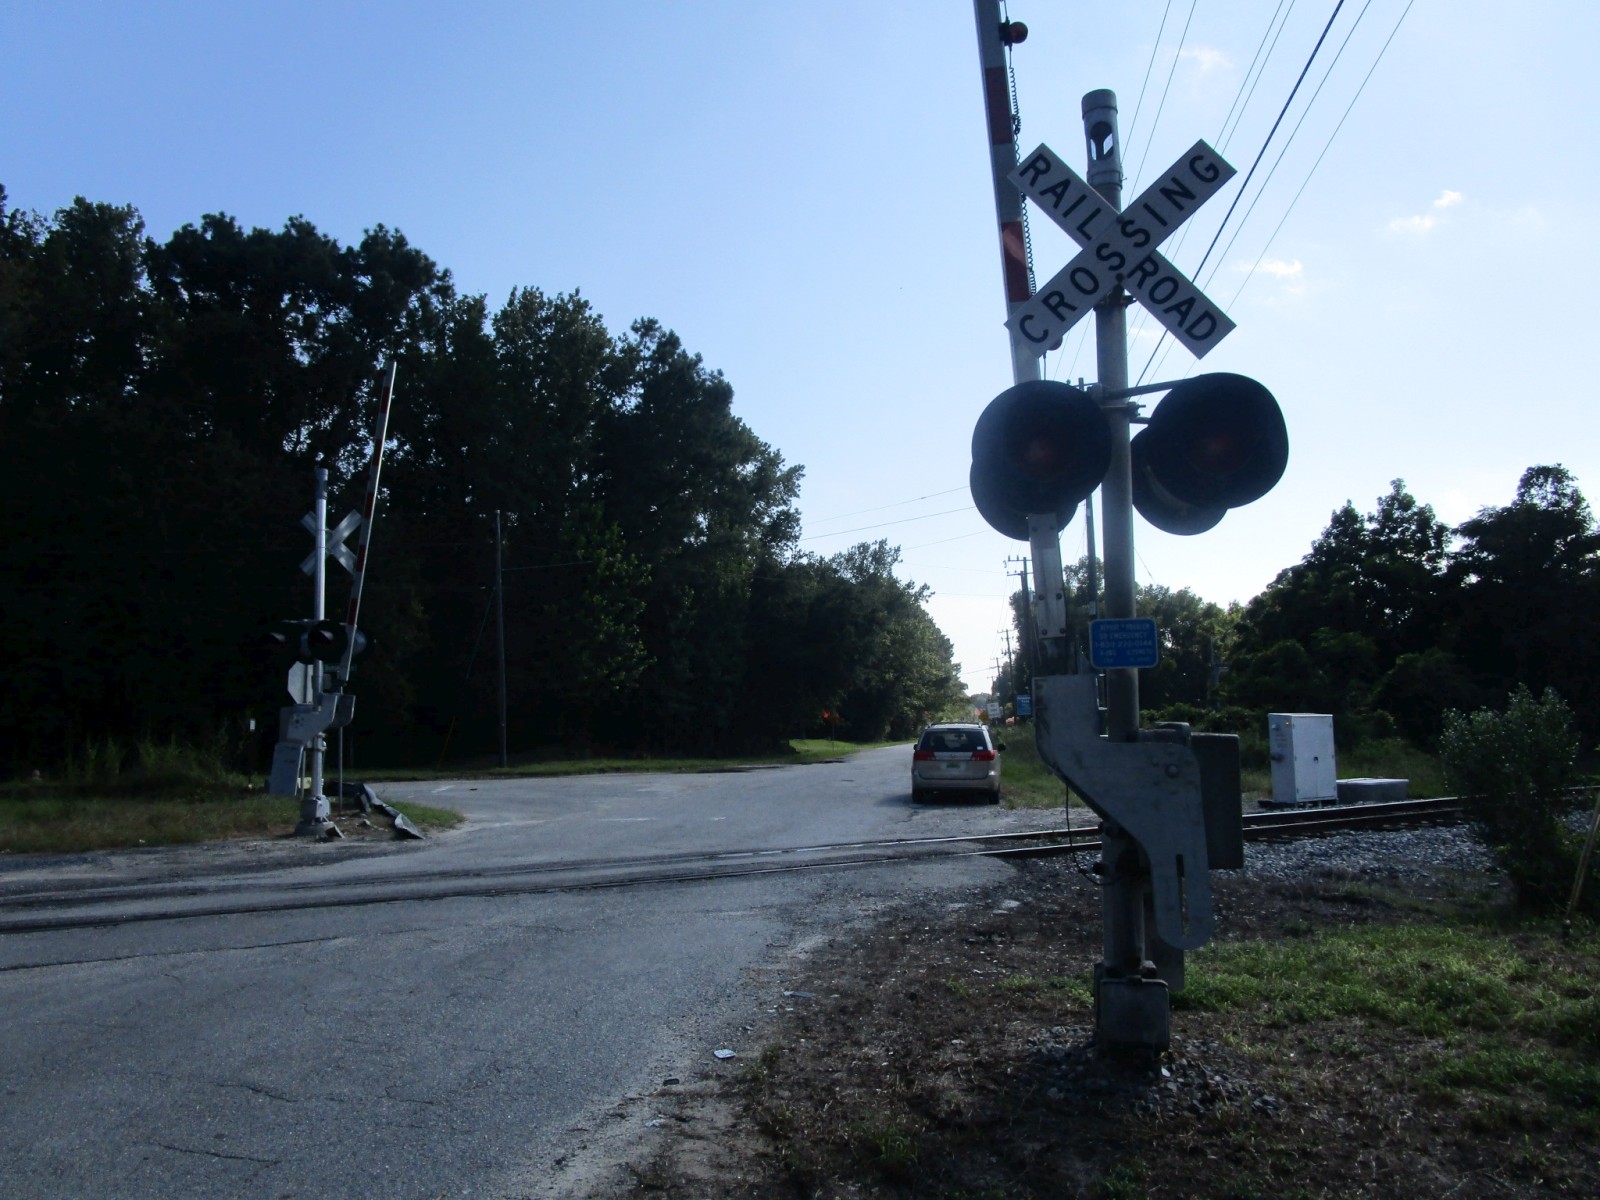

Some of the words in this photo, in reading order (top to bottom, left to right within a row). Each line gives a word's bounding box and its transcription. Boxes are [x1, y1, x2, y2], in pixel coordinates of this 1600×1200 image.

[1018, 153, 1101, 241] RAIL
[1127, 256, 1217, 341] ROAD
[1019, 154, 1220, 344] CROSSING
